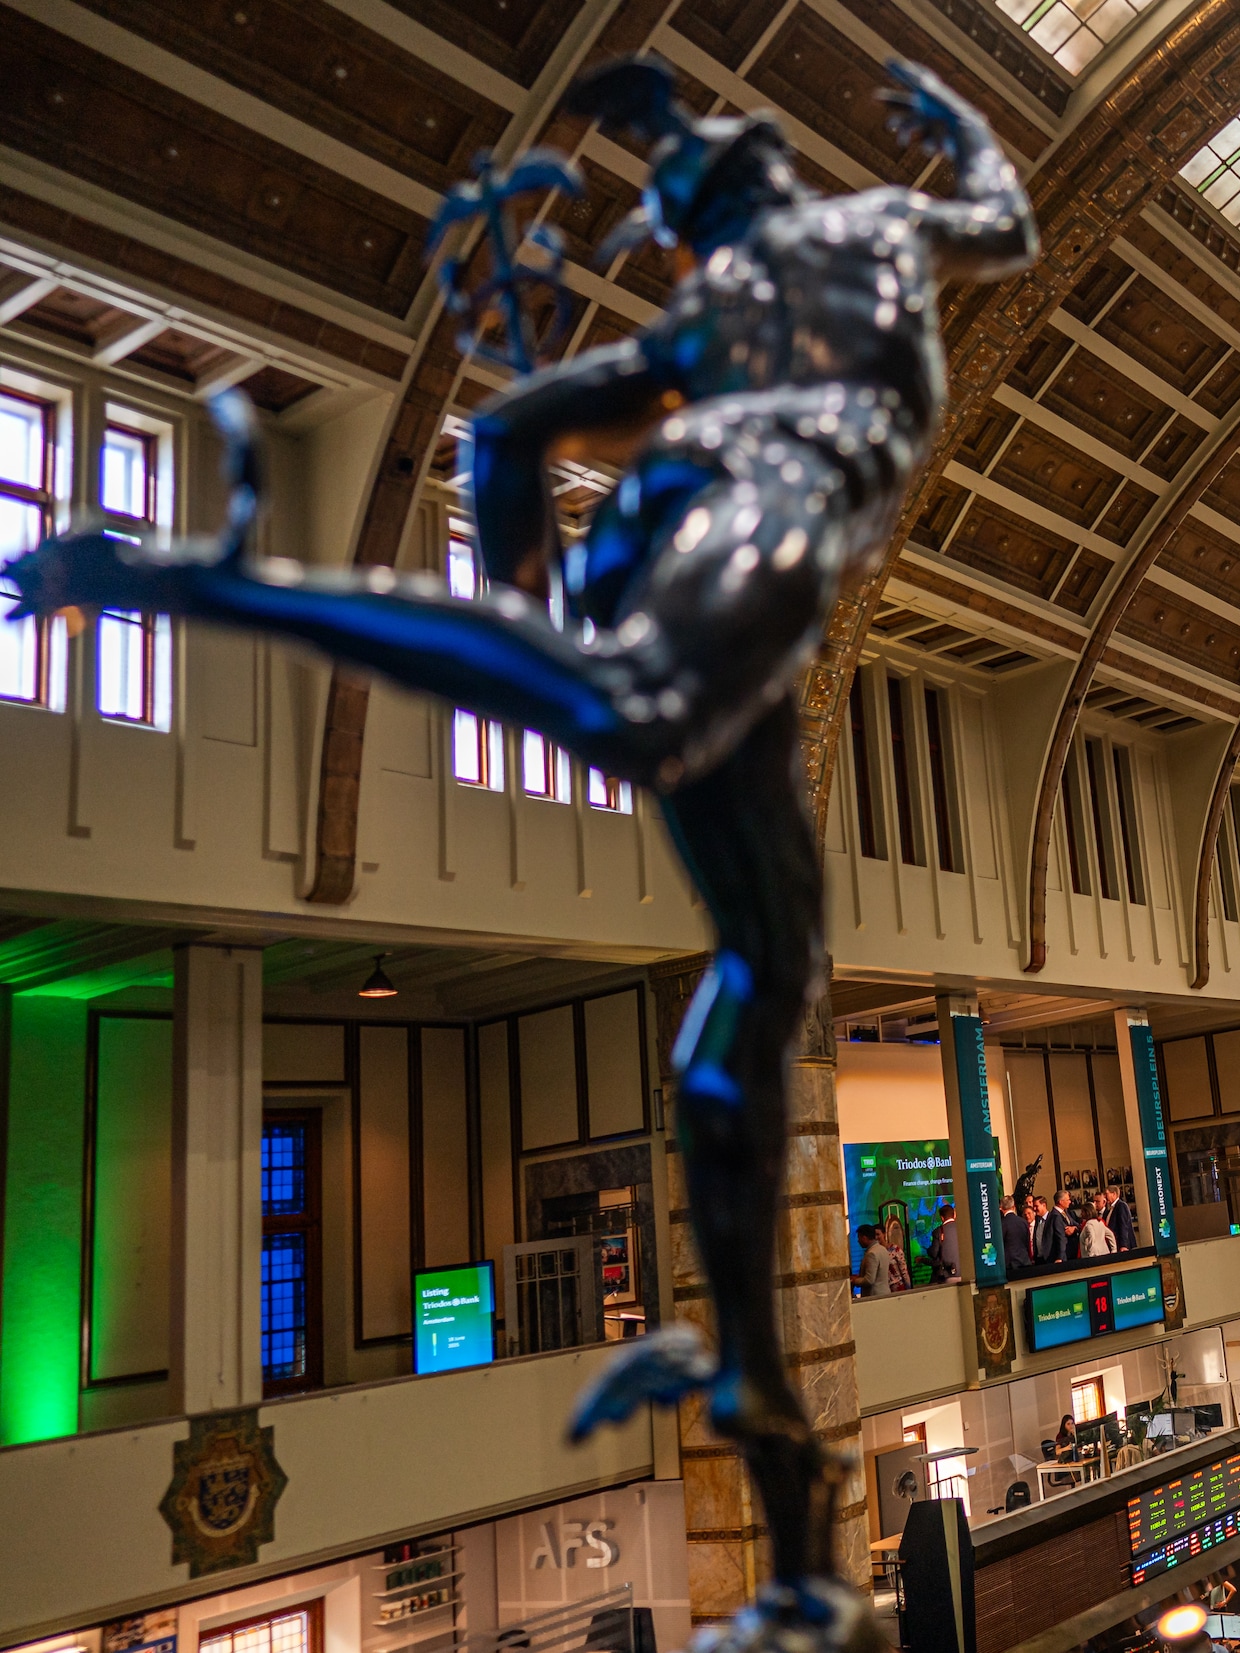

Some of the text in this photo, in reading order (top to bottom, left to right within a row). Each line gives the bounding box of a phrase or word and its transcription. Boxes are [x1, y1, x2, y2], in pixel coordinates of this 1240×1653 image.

[975, 1027, 993, 1135] AMSTERDAM
[1146, 1035, 1166, 1141] BEURSPLEIN 5
[896, 1157, 927, 1170] Triodos
[1155, 1166, 1166, 1216] EURONEXT
[980, 1182, 992, 1240] EURONEXT
[422, 1288, 450, 1298] Listing
[422, 1295, 480, 1310] Triodos Bank
[1095, 1296, 1108, 1314] 18
[1038, 1311, 1056, 1322] Triodos
[1060, 1309, 1071, 1317] Bank
[529, 1521, 614, 1570] AFS
